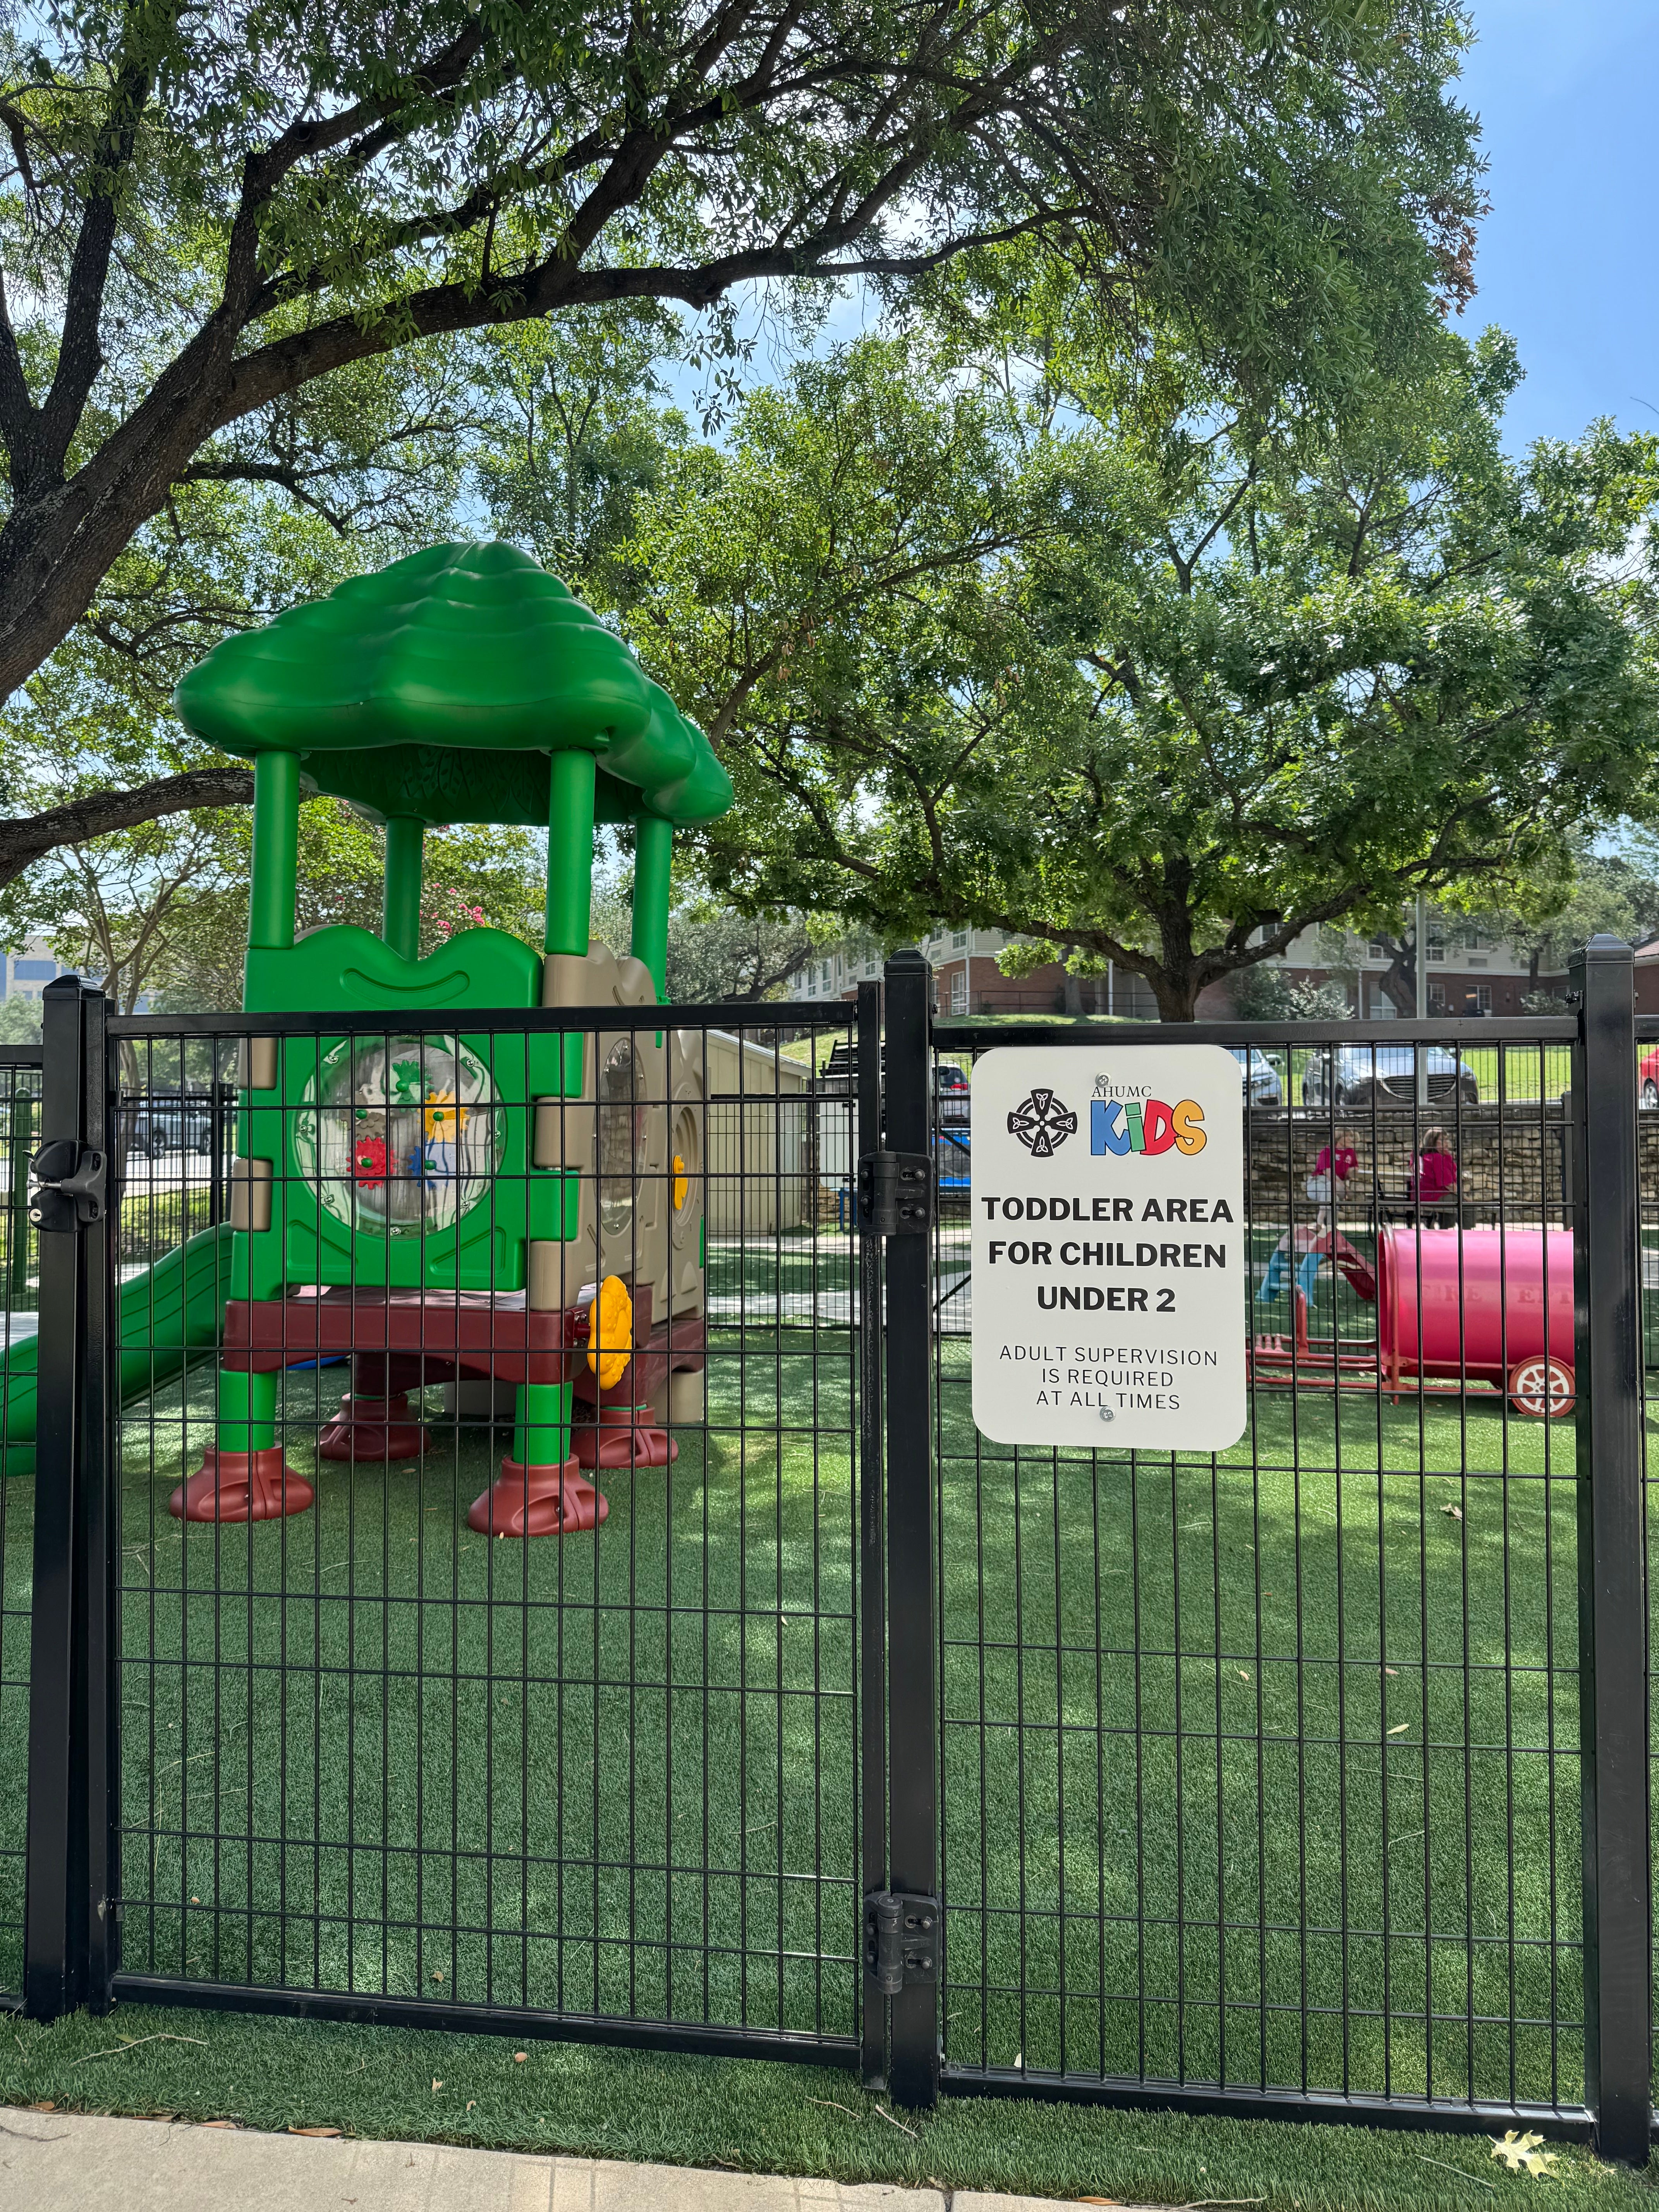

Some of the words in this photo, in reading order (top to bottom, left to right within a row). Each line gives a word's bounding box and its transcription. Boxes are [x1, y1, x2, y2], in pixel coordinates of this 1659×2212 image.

[1091, 1086, 1151, 1097] AHUMC
[981, 1197, 1133, 1221] TODDLER
[1141, 1199, 1234, 1223] AREA
[989, 1241, 1052, 1265] FOR
[1060, 1242, 1226, 1268] CHILDREN
[1038, 1286, 1148, 1312] UNDER
[1156, 1288, 1176, 1312] 2
[1000, 1345, 1067, 1361] ADULT
[1075, 1347, 1217, 1366] SUPERVISION
[1042, 1368, 1060, 1383] IS
[1068, 1369, 1173, 1387] REQUIRED
[1036, 1391, 1062, 1405] AT
[1070, 1392, 1108, 1407] ALL
[1115, 1393, 1180, 1410] TIMES
